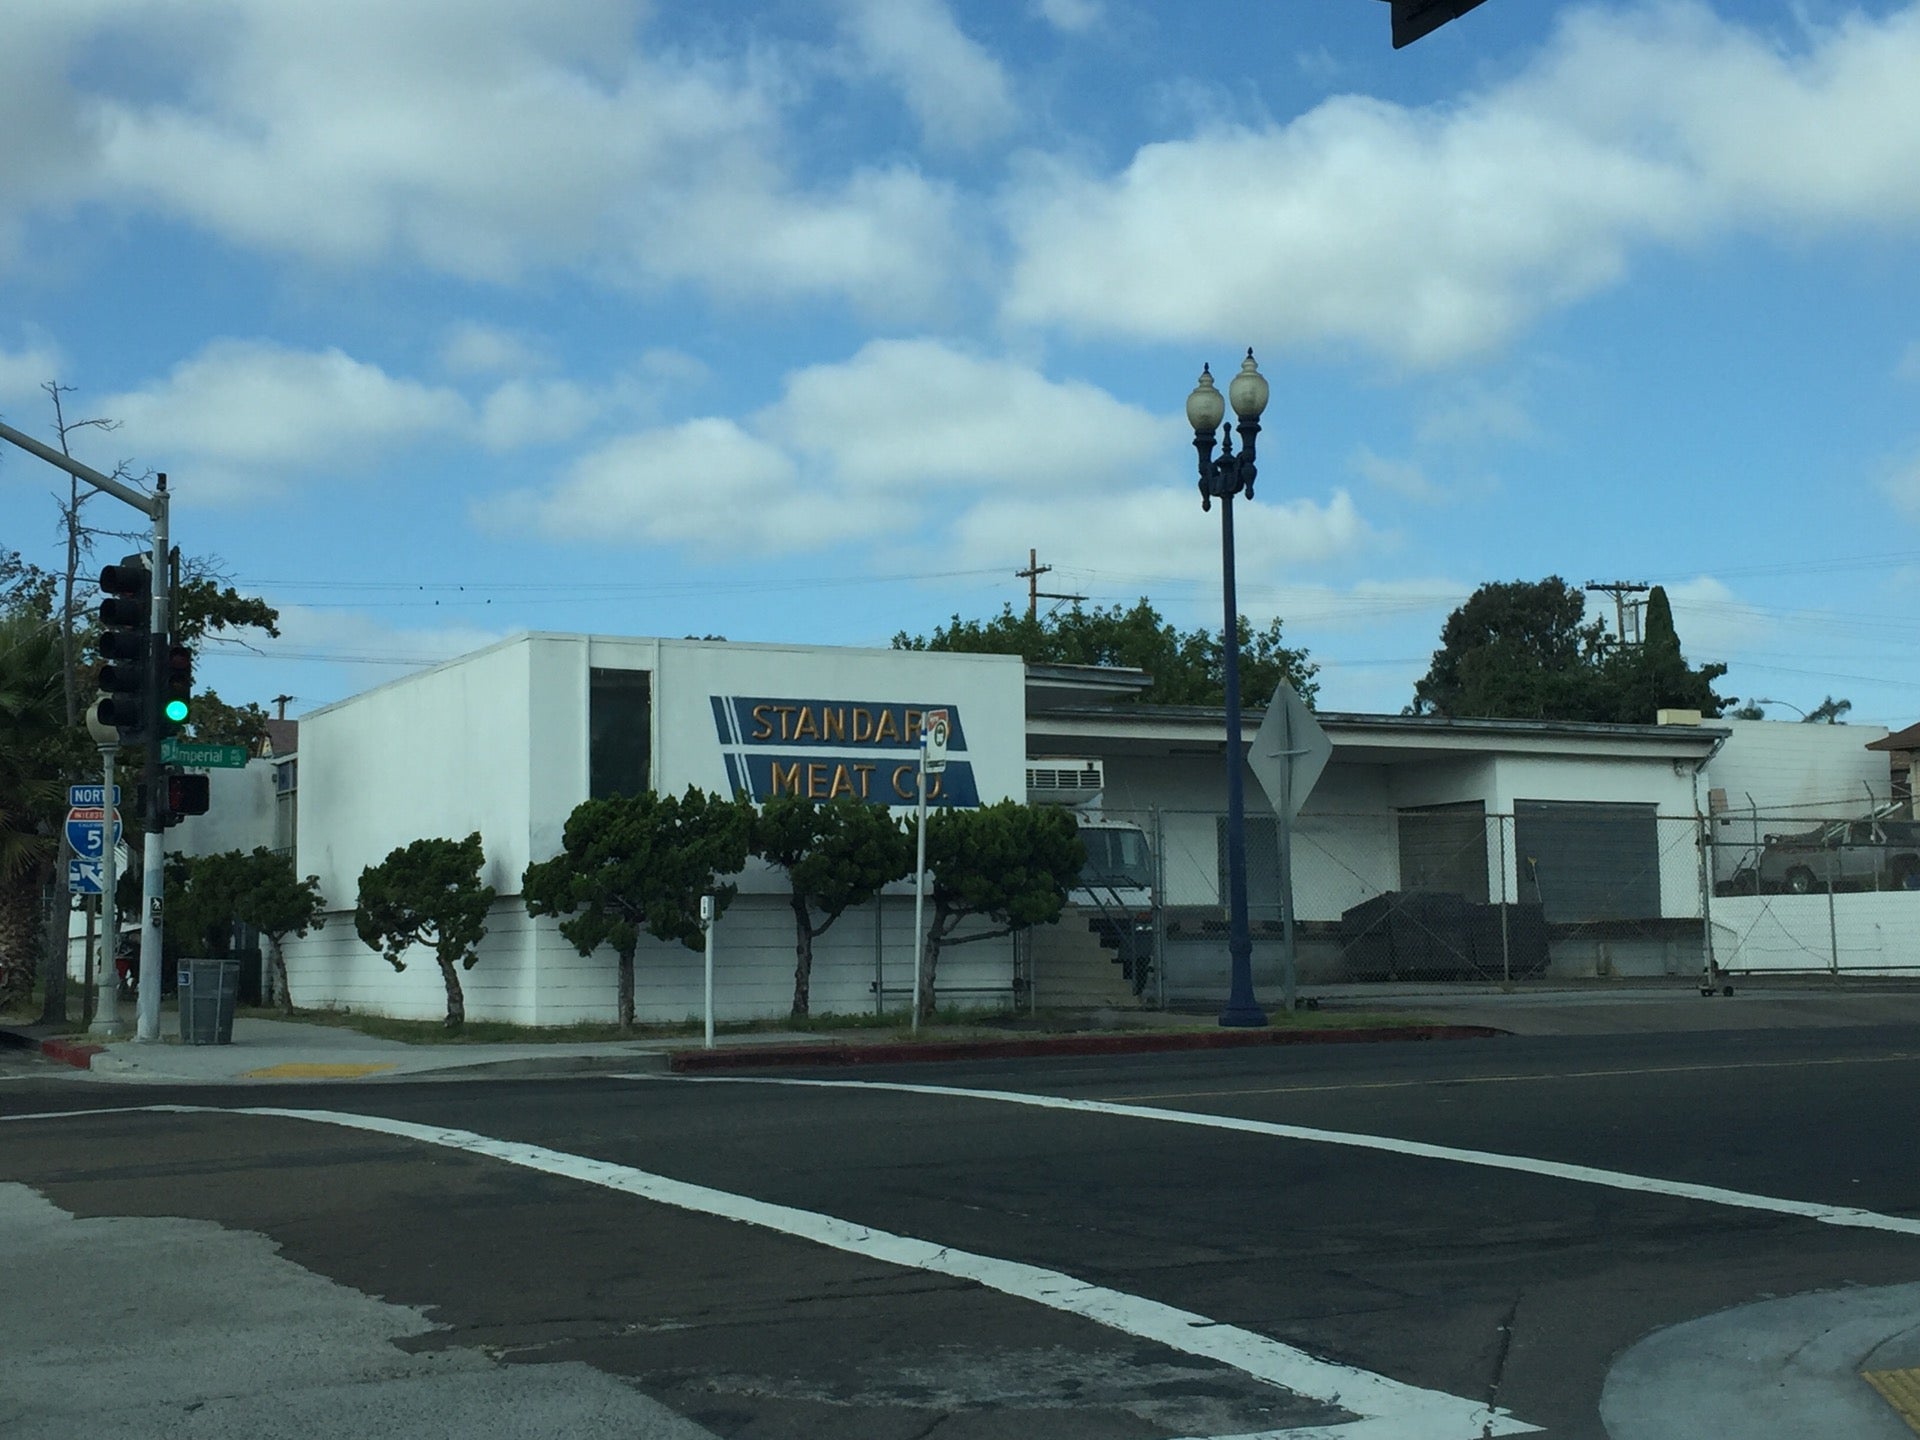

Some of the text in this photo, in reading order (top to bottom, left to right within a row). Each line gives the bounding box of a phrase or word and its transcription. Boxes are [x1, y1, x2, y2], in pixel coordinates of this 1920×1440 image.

[752, 704, 951, 744] STANDAR
[771, 760, 949, 800] MEAT CO.
[87, 829, 102, 850] 5
